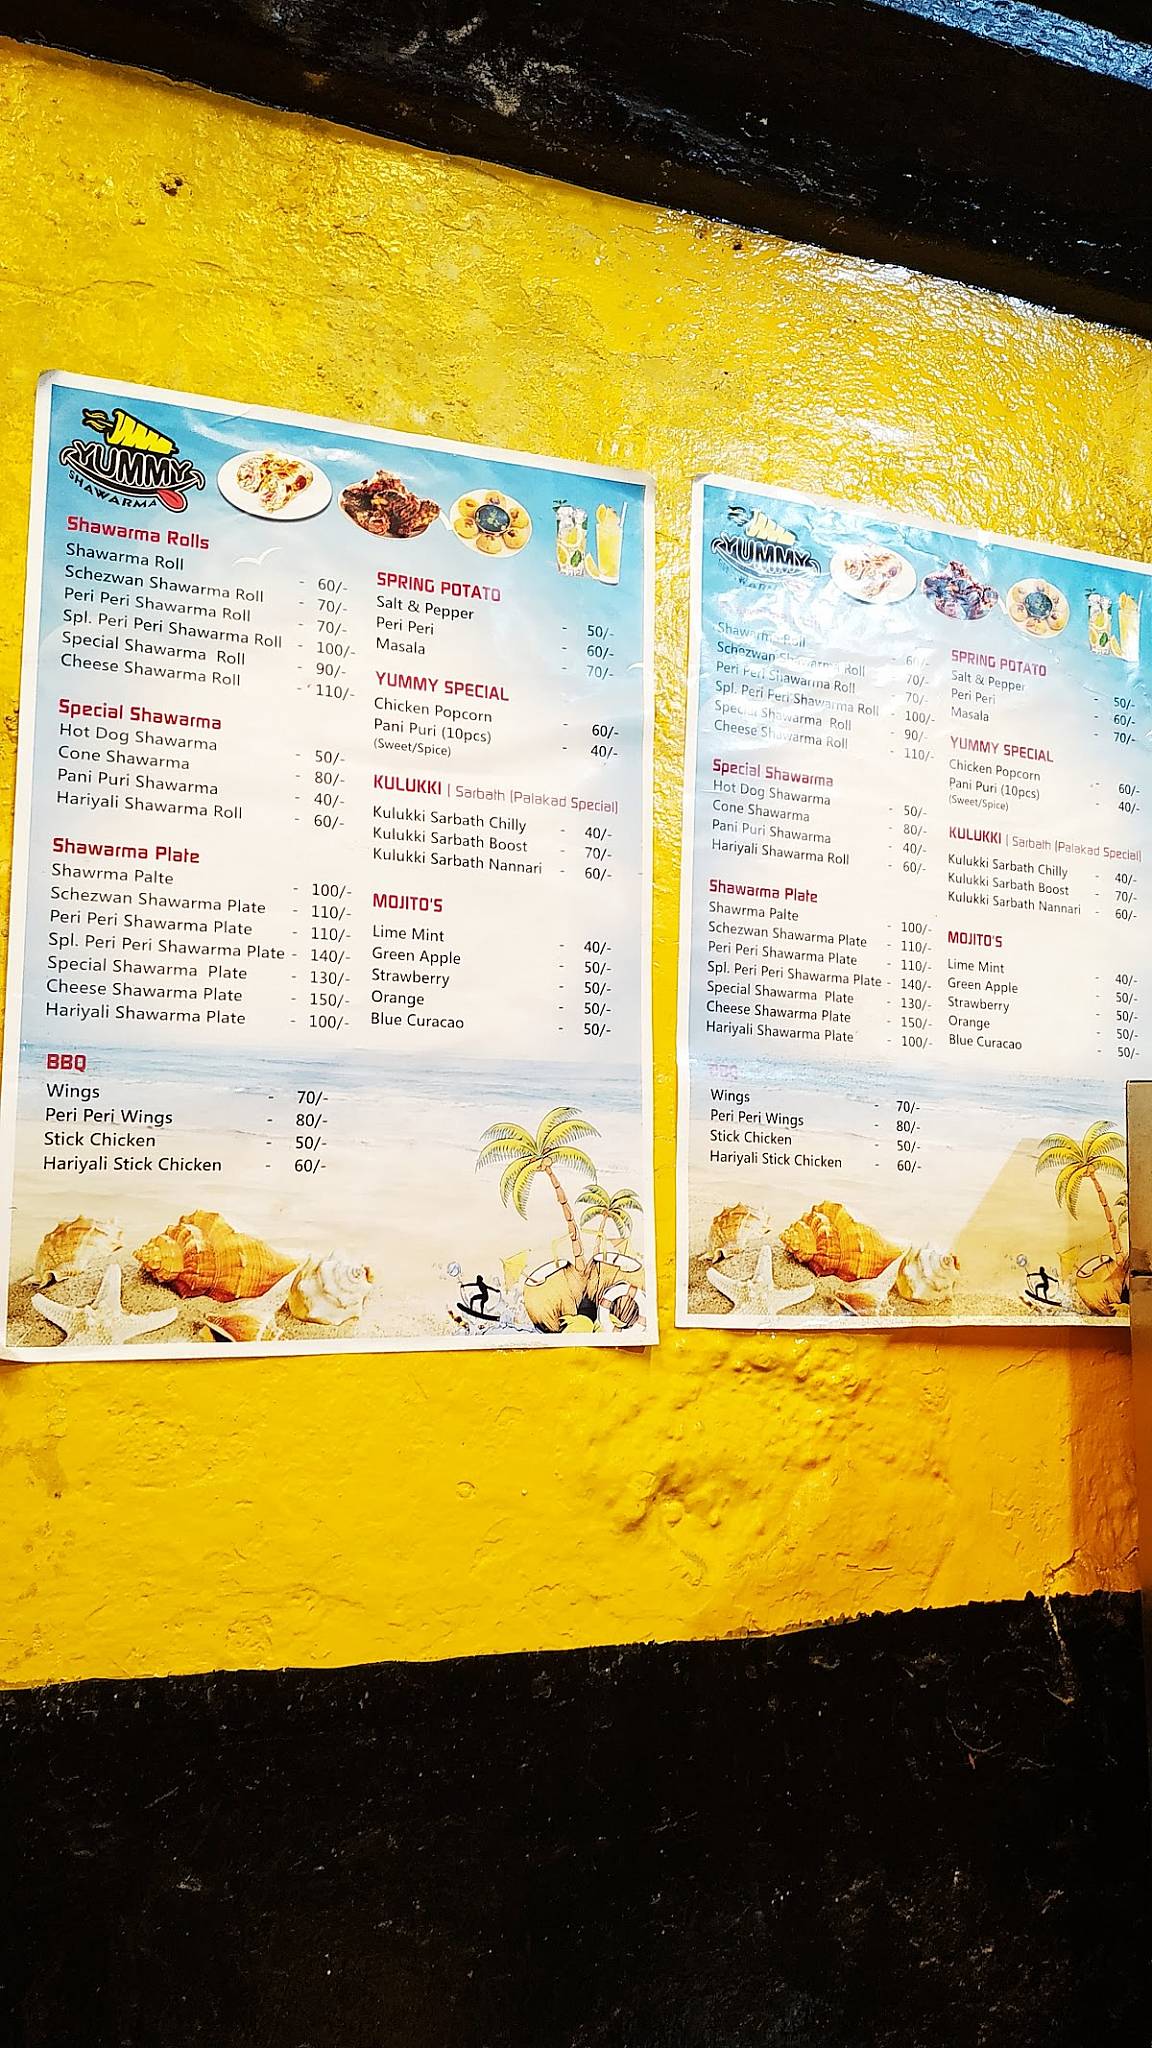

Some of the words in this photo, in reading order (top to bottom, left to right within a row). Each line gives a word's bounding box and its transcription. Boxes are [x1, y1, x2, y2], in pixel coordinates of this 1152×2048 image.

[73, 440, 193, 487] YUMMY
[68, 470, 157, 508] SHAWARMA
[67, 515, 160, 543] Shawarma
[167, 530, 209, 550] Rolls
[720, 531, 811, 573] YUMMY
[65, 542, 149, 566] Shawarma
[155, 555, 184, 571] Roll
[318, 578, 347, 594] 60/-
[65, 564, 144, 587] Schezwan
[149, 576, 230, 598] Shawarma
[236, 588, 263, 603] Roll
[317, 598, 347, 615] 70/-
[377, 571, 435, 593] SPRING
[441, 581, 501, 602] POTATO
[64, 586, 94, 602] Peri
[100, 591, 130, 606] Peri
[135, 596, 216, 618] Shawarma
[222, 607, 250, 622] Roll
[317, 619, 347, 636] 70/-
[376, 595, 403, 611] Salt
[407, 600, 420, 613] &
[425, 602, 474, 621] Pepper
[587, 624, 613, 640] 50/-
[63, 608, 92, 626] Spl.
[98, 612, 128, 628] Peri
[134, 616, 163, 633] Peri
[168, 621, 249, 644] Shawarma
[254, 633, 282, 648] Roll
[317, 641, 355, 658] 100/-
[376, 616, 402, 631] Peri
[408, 620, 434, 635] Peri
[587, 644, 614, 660] 60/-
[376, 636, 425, 655] Masala
[587, 665, 613, 680] 70/-
[951, 649, 996, 668] SPRING
[1000, 658, 1047, 677] POTATO
[375, 670, 439, 692] YUMMY
[444, 680, 509, 702] SPECIAL
[58, 698, 123, 720] Special
[130, 706, 221, 730] Shawarma
[374, 697, 429, 715] Chicken
[435, 704, 492, 723] Popcorn
[591, 724, 619, 739] 60/-
[951, 706, 989, 722] Masala
[59, 723, 90, 738] Hot
[96, 726, 129, 745] Dog
[135, 730, 217, 751] Shawarma
[315, 749, 344, 766] 50/-
[374, 717, 404, 733] Pani
[409, 722, 436, 737] Puri
[590, 744, 618, 759] 40/-
[950, 735, 999, 754] YUMMY
[1003, 744, 1054, 763] SPECIAL
[58, 745, 101, 762] Cone
[106, 749, 189, 770] Shawarma
[314, 771, 344, 787] 80/-
[712, 758, 761, 777] Special
[765, 766, 833, 787] Shawarma
[949, 758, 992, 774] Chicken
[995, 764, 1041, 781] Popcorn
[58, 768, 92, 783] Pani
[98, 771, 130, 786] Puri
[135, 774, 218, 795] Shawarma
[313, 792, 344, 808] 40/-
[373, 774, 441, 795] KULUKKI
[455, 785, 505, 801] Sarbath
[57, 790, 119, 810] Hariyali
[124, 796, 208, 816] Shawarma
[214, 804, 242, 819] Roll
[314, 814, 344, 830] 60/-
[373, 805, 425, 822] Kulukki
[430, 811, 484, 827] Sarbath
[489, 816, 527, 835] Chilly
[584, 826, 612, 841] 40/-
[712, 799, 744, 814] Cone
[747, 803, 810, 822] Shawarma
[52, 837, 148, 859] Shawarma
[155, 846, 200, 864] Plate
[712, 838, 758, 856] Hariyali
[761, 844, 824, 862] Shawarma
[827, 852, 849, 865] Roll
[949, 826, 1002, 844] KULUKKI
[1012, 835, 1051, 850] Sarbath
[373, 847, 425, 864] Kulukki
[430, 852, 484, 869] Sarbath
[489, 858, 542, 874] Nannari
[584, 867, 612, 882] 60/-
[51, 862, 128, 881] Shawrma
[134, 869, 174, 885] Palte
[312, 883, 352, 899] 100/-
[709, 879, 780, 899] Shawarma
[784, 887, 818, 903] Plate
[948, 872, 989, 887] Kulukki
[992, 877, 1035, 892] Sarbath
[1038, 882, 1069, 896] Boost
[373, 893, 443, 913] MOJITO'S
[373, 924, 407, 940] Lime
[411, 927, 444, 942] Mint
[583, 940, 611, 955] 40/-
[947, 930, 1003, 948] MOJITO'S
[372, 946, 415, 961] Green
[419, 950, 461, 967] Apple
[584, 961, 611, 976] 50/-
[371, 967, 450, 989] Strawberry
[584, 981, 611, 996] 50/-
[46, 1001, 109, 1021] Hariyali
[115, 1005, 200, 1022] Shawarma
[206, 1009, 246, 1025] Plate
[309, 1014, 349, 1031] 100/-
[371, 989, 425, 1008] Orange
[584, 1002, 611, 1017] 50/-
[706, 1000, 751, 1015] Cheese
[754, 1004, 817, 1020] Shawarma
[821, 1009, 851, 1023] Plate
[947, 995, 1010, 1014] Strawberry
[371, 1011, 402, 1026] Blue
[407, 1013, 464, 1029] Curacao
[583, 1022, 611, 1038] 50/-
[949, 1033, 974, 1046] Blue
[976, 1035, 1022, 1050] Curacao
[46, 1053, 86, 1073] BBQ
[46, 1083, 100, 1102] Wings
[297, 1090, 328, 1106] 70/-
[710, 1088, 750, 1106] Wings
[45, 1107, 77, 1122] Peri
[83, 1108, 115, 1123] Peri
[120, 1109, 173, 1128] Wings
[295, 1113, 328, 1129] 80/-
[44, 1131, 84, 1146] Stick
[90, 1132, 156, 1147] Chicken
[295, 1135, 327, 1152] 50/-
[43, 1155, 108, 1174] Hariyali
[113, 1156, 153, 1171] Stick
[158, 1157, 222, 1171] Chicken
[294, 1158, 326, 1174] 60/-
